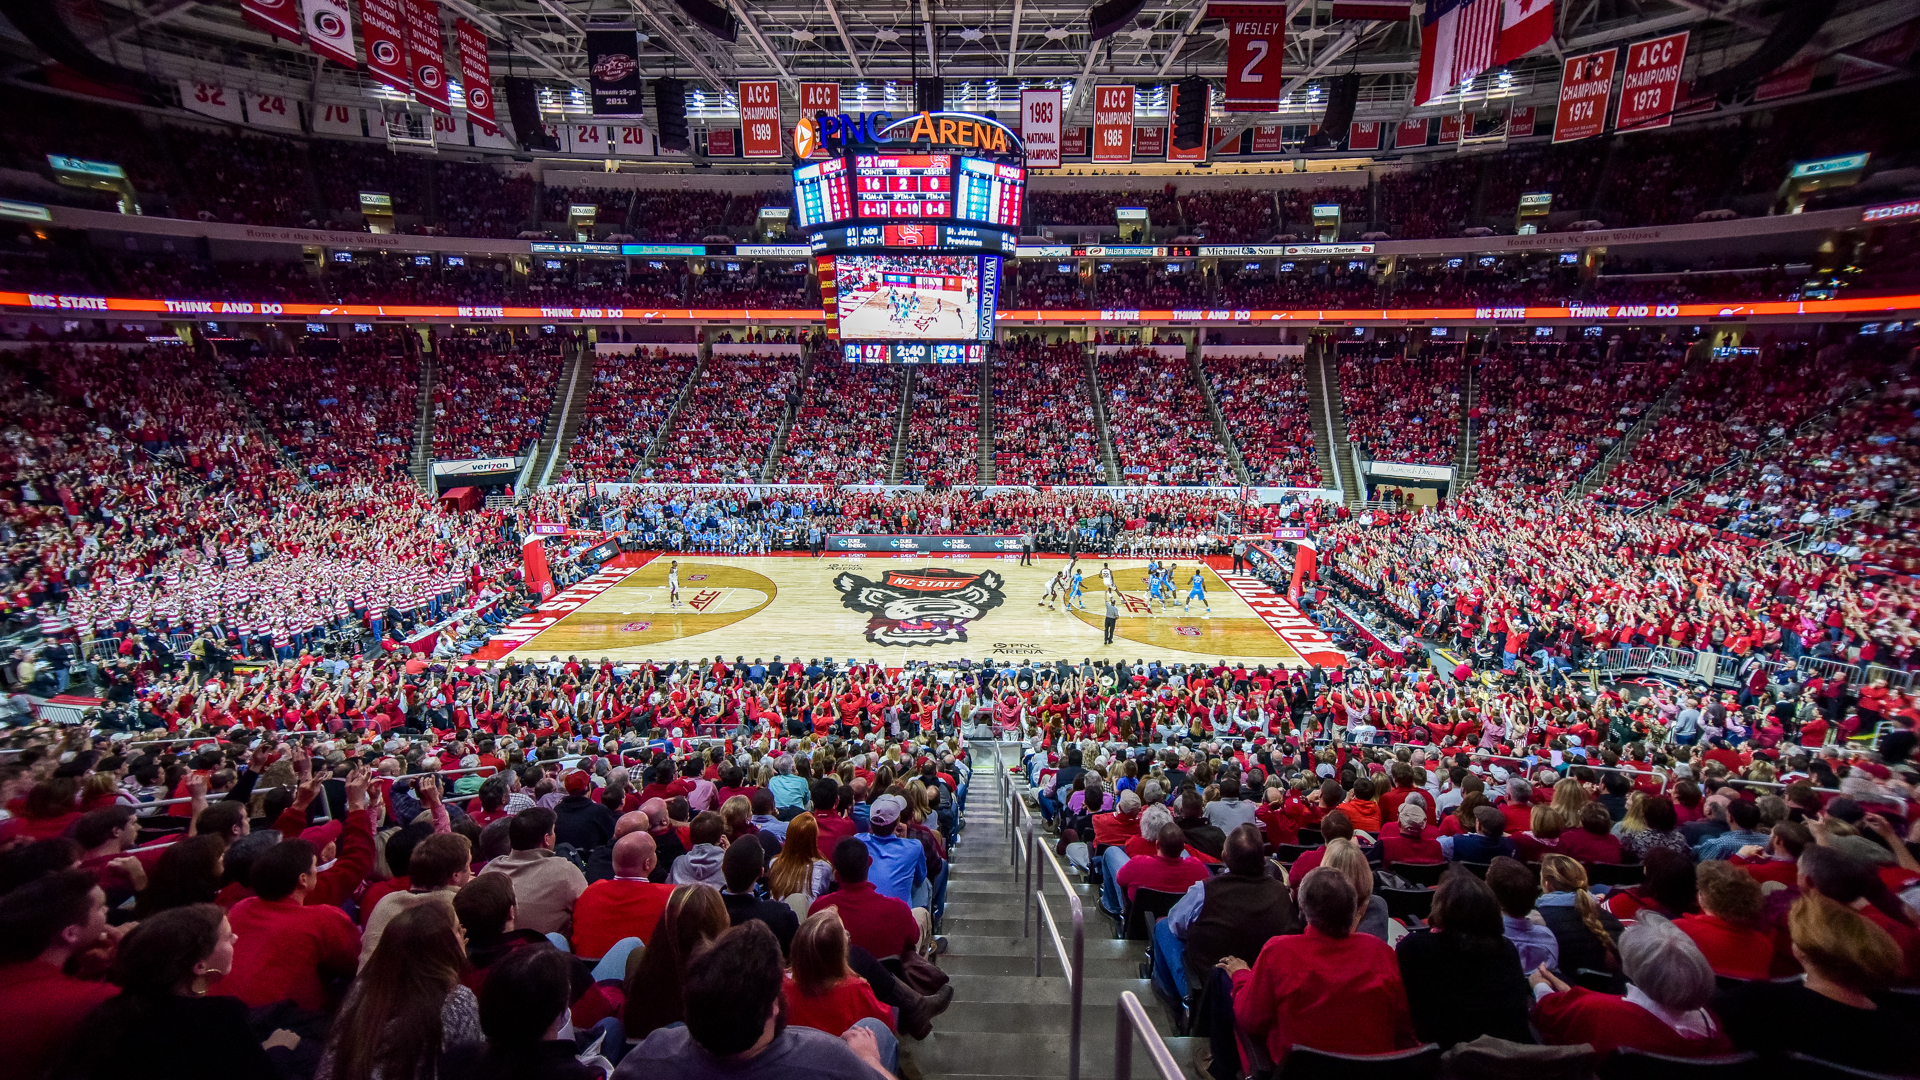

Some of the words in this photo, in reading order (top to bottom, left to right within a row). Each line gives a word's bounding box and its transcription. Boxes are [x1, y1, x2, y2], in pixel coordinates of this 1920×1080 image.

[365, 0, 395, 22] DIVISION
[363, 12, 401, 39] CHAMPIONS
[1235, 22, 1279, 36] WESLEY
[460, 42, 487, 63] SOUTHEAST
[1637, 41, 1673, 68] ACC
[464, 56, 486, 73] DIVISION
[1240, 39, 1269, 83] 2
[1626, 64, 1678, 89] CHAMPIONS
[748, 85, 770, 103] ACC
[809, 87, 830, 105] ACC
[1563, 79, 1609, 101] CHAMPIONS
[606, 97, 628, 105] 2011
[1103, 90, 1126, 108] ACC
[1633, 88, 1661, 112] 1973
[743, 107, 777, 120] CHAMPIONS
[1029, 102, 1053, 124] 1983
[1096, 112, 1131, 125] CHAMPIONS
[1569, 101, 1594, 122] 1974
[578, 126, 600, 143] 24
[623, 127, 643, 144] 20
[752, 123, 772, 140] 1989
[818, 110, 893, 149] PNC
[910, 110, 1007, 152] ARENA
[1026, 132, 1056, 144] NATIONAL
[1103, 129, 1123, 147] 1985
[857, 156, 873, 168] 22
[999, 164, 1020, 179] NCSU
[865, 178, 880, 190] 16
[899, 178, 908, 190] 2
[930, 177, 939, 190] 0
[864, 203, 887, 215] 6-13
[895, 203, 918, 215] 4-10
[926, 203, 945, 215] 0-0
[245, 229, 277, 238] Home
[281, 232, 291, 240] of
[294, 233, 309, 241] the
[329, 235, 353, 243] State
[356, 236, 399, 246] Wolfpack
[846, 228, 856, 236] 61
[1536, 237, 1547, 245] of
[1550, 236, 1564, 244] the
[1613, 231, 1661, 241] Wolfpack
[750, 247, 803, 255] rexhealth.com
[1206, 247, 1240, 255] Michael
[1257, 247, 1274, 255] Son
[29, 294, 57, 308] NC
[59, 296, 108, 310] STATE
[164, 300, 213, 313] THINK
[221, 302, 253, 314] AND
[261, 303, 283, 314] DO
[458, 307, 473, 316] NC
[475, 307, 504, 317] STATE
[541, 308, 573, 317] THINK
[579, 308, 602, 317] AND
[608, 308, 623, 317] DO
[982, 296, 992, 337] NEWS
[1101, 311, 1114, 320] NC
[1114, 311, 1139, 320] STATE
[1173, 311, 1202, 320] THINK
[1207, 311, 1230, 320] AND
[1234, 311, 1250, 320] DO
[1476, 308, 1491, 318] NC
[1493, 308, 1526, 318] STATE
[1569, 307, 1609, 318] THINK
[1616, 306, 1648, 317] AND
[1655, 306, 1679, 316] DO
[865, 345, 881, 357] 67
[896, 345, 925, 357] 2:40
[942, 345, 957, 357] 73
[969, 345, 979, 357] 67
[472, 461, 509, 471] verizon
[542, 525, 559, 533] REX
[894, 577, 914, 585] NC
[917, 580, 963, 588] STATE
[487, 617, 558, 643] NC
[538, 566, 638, 611] STATE
[689, 590, 718, 610] ACC
[1216, 568, 1346, 655] WOLFPACK
